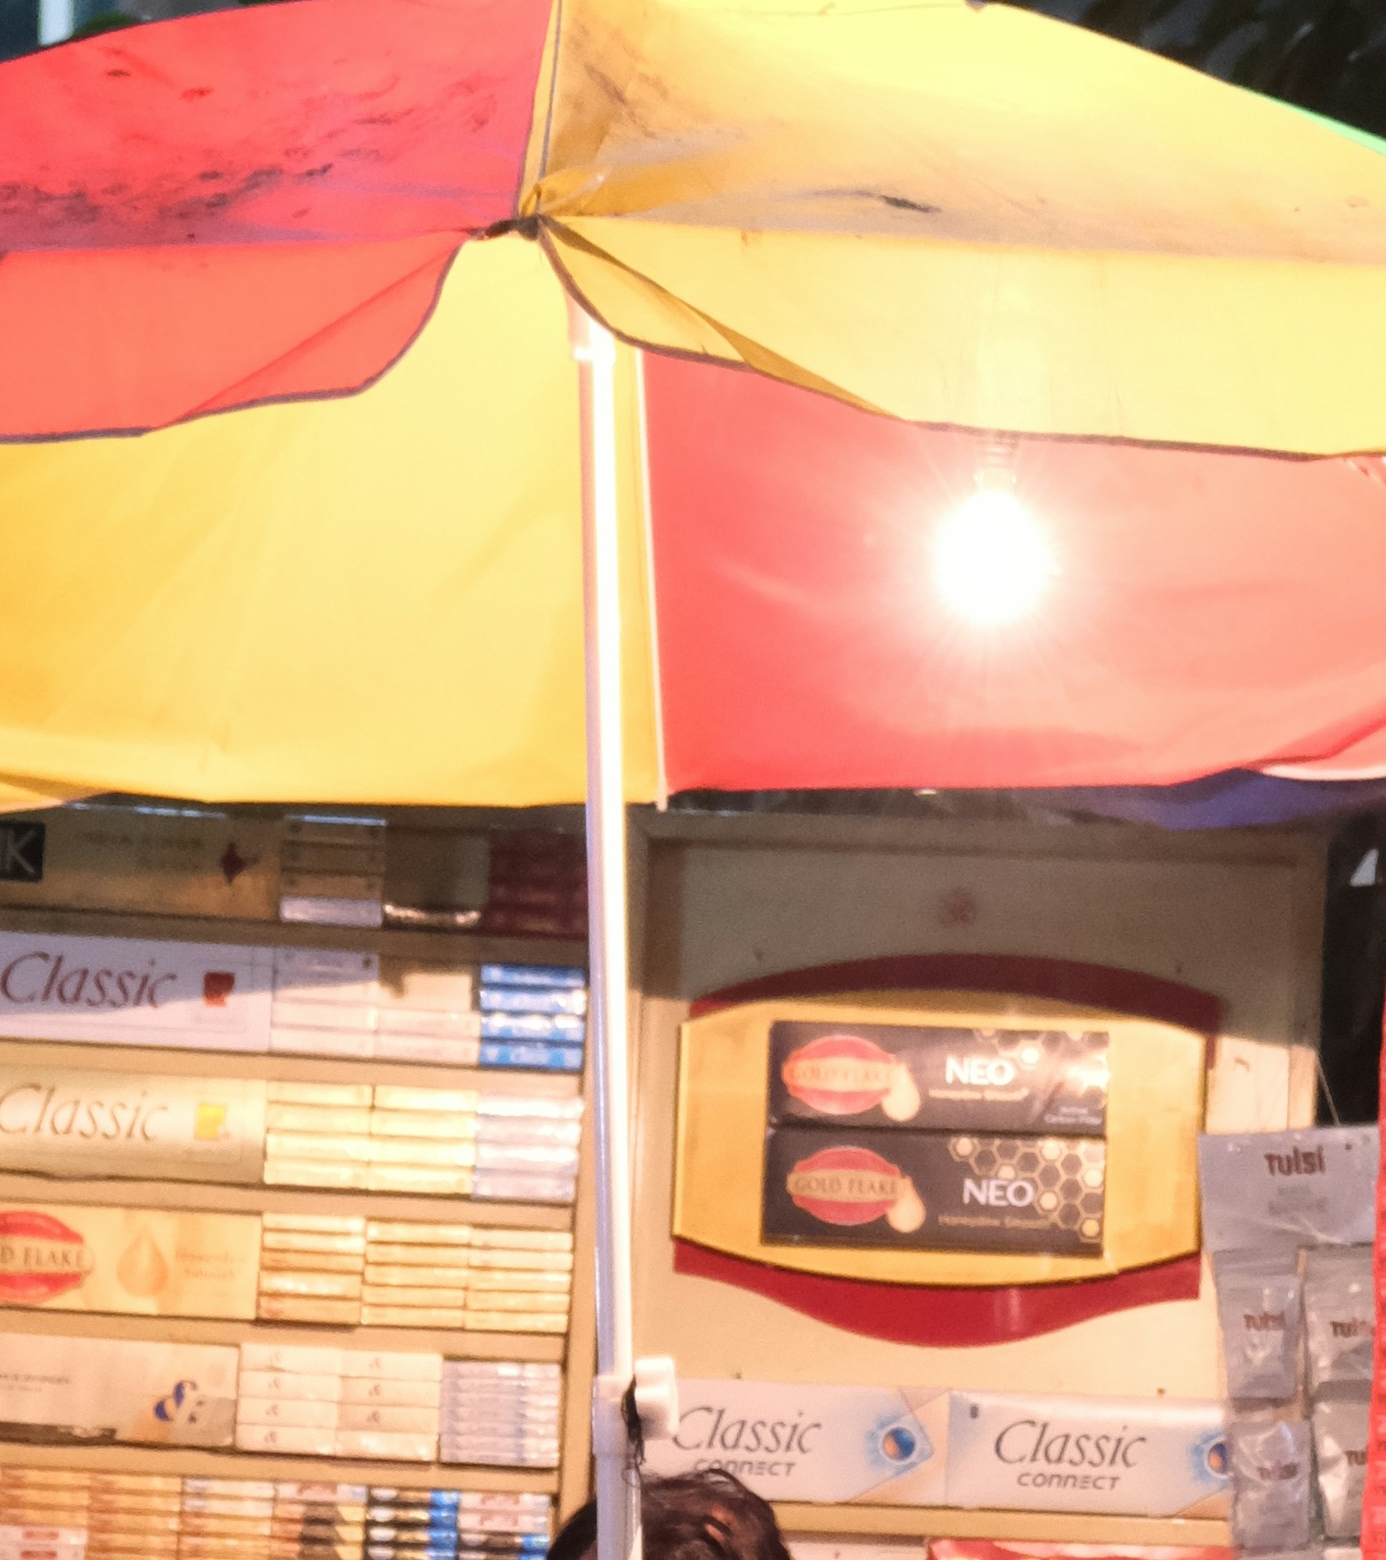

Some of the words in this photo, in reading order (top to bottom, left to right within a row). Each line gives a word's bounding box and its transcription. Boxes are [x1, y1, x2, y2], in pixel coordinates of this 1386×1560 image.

[0, 951, 178, 1009] Classic
[945, 1054, 1015, 1086] NEO
[962, 1179, 1034, 1208] NEO
[22, 1245, 86, 1269] FLAKE
[673, 1406, 821, 1455] Classic
[994, 1419, 1147, 1468] Classic
